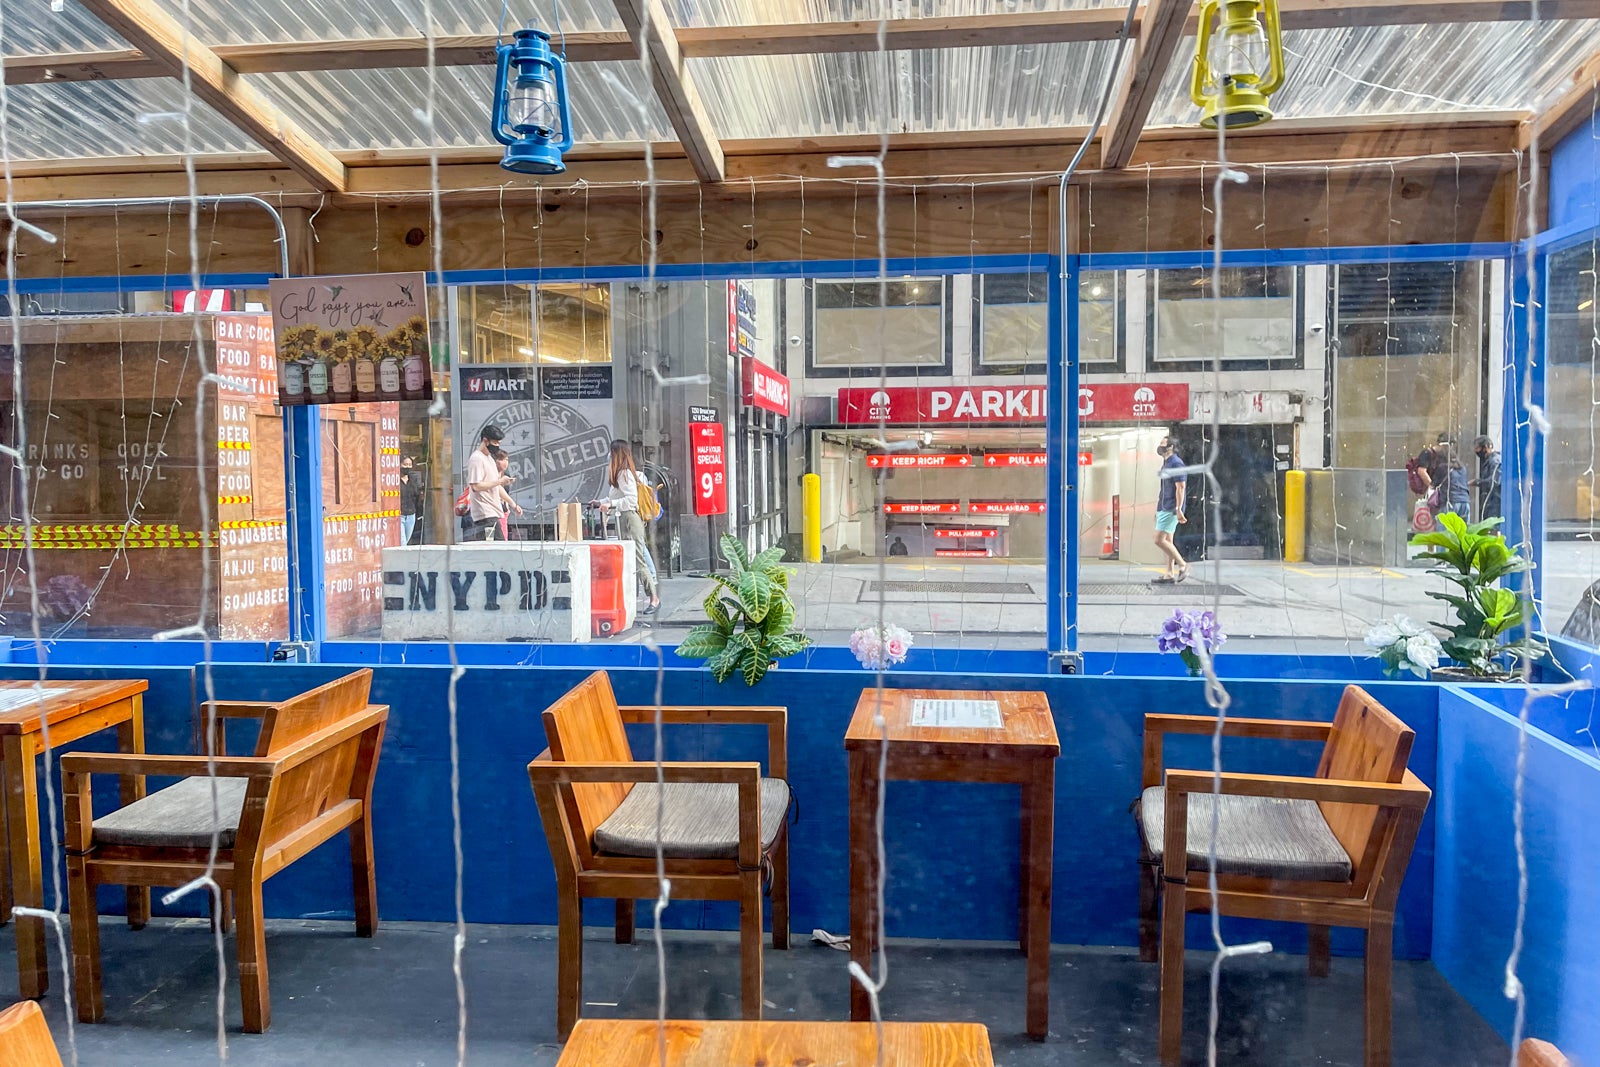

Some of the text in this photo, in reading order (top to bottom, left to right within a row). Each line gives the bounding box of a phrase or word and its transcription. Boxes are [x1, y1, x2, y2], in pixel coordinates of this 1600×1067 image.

[279, 286, 318, 324] God
[321, 300, 351, 328] says
[350, 300, 383, 327] you
[218, 321, 243, 339] BAR
[219, 347, 251, 367] FOOD
[484, 378, 528, 391] MART
[931, 389, 1095, 419] PARKIG
[1132, 403, 1157, 412] CITY
[222, 404, 246, 422] BAR
[382, 417, 397, 431] BAR
[218, 426, 249, 443] BEER
[380, 435, 399, 449] BEER
[218, 451, 250, 467] SOJU
[380, 454, 400, 468] SOJU
[697, 454, 723, 465] SPECIAL
[892, 456, 946, 466] KEEP RIGHT
[1008, 456, 1032, 465] PULL
[219, 474, 251, 491] FOOD
[380, 472, 401, 487] FOOD
[701, 472, 714, 499] 9
[223, 560, 255, 577] ANJU
[331, 577, 353, 595] FOOD
[409, 570, 548, 611] NYPD
